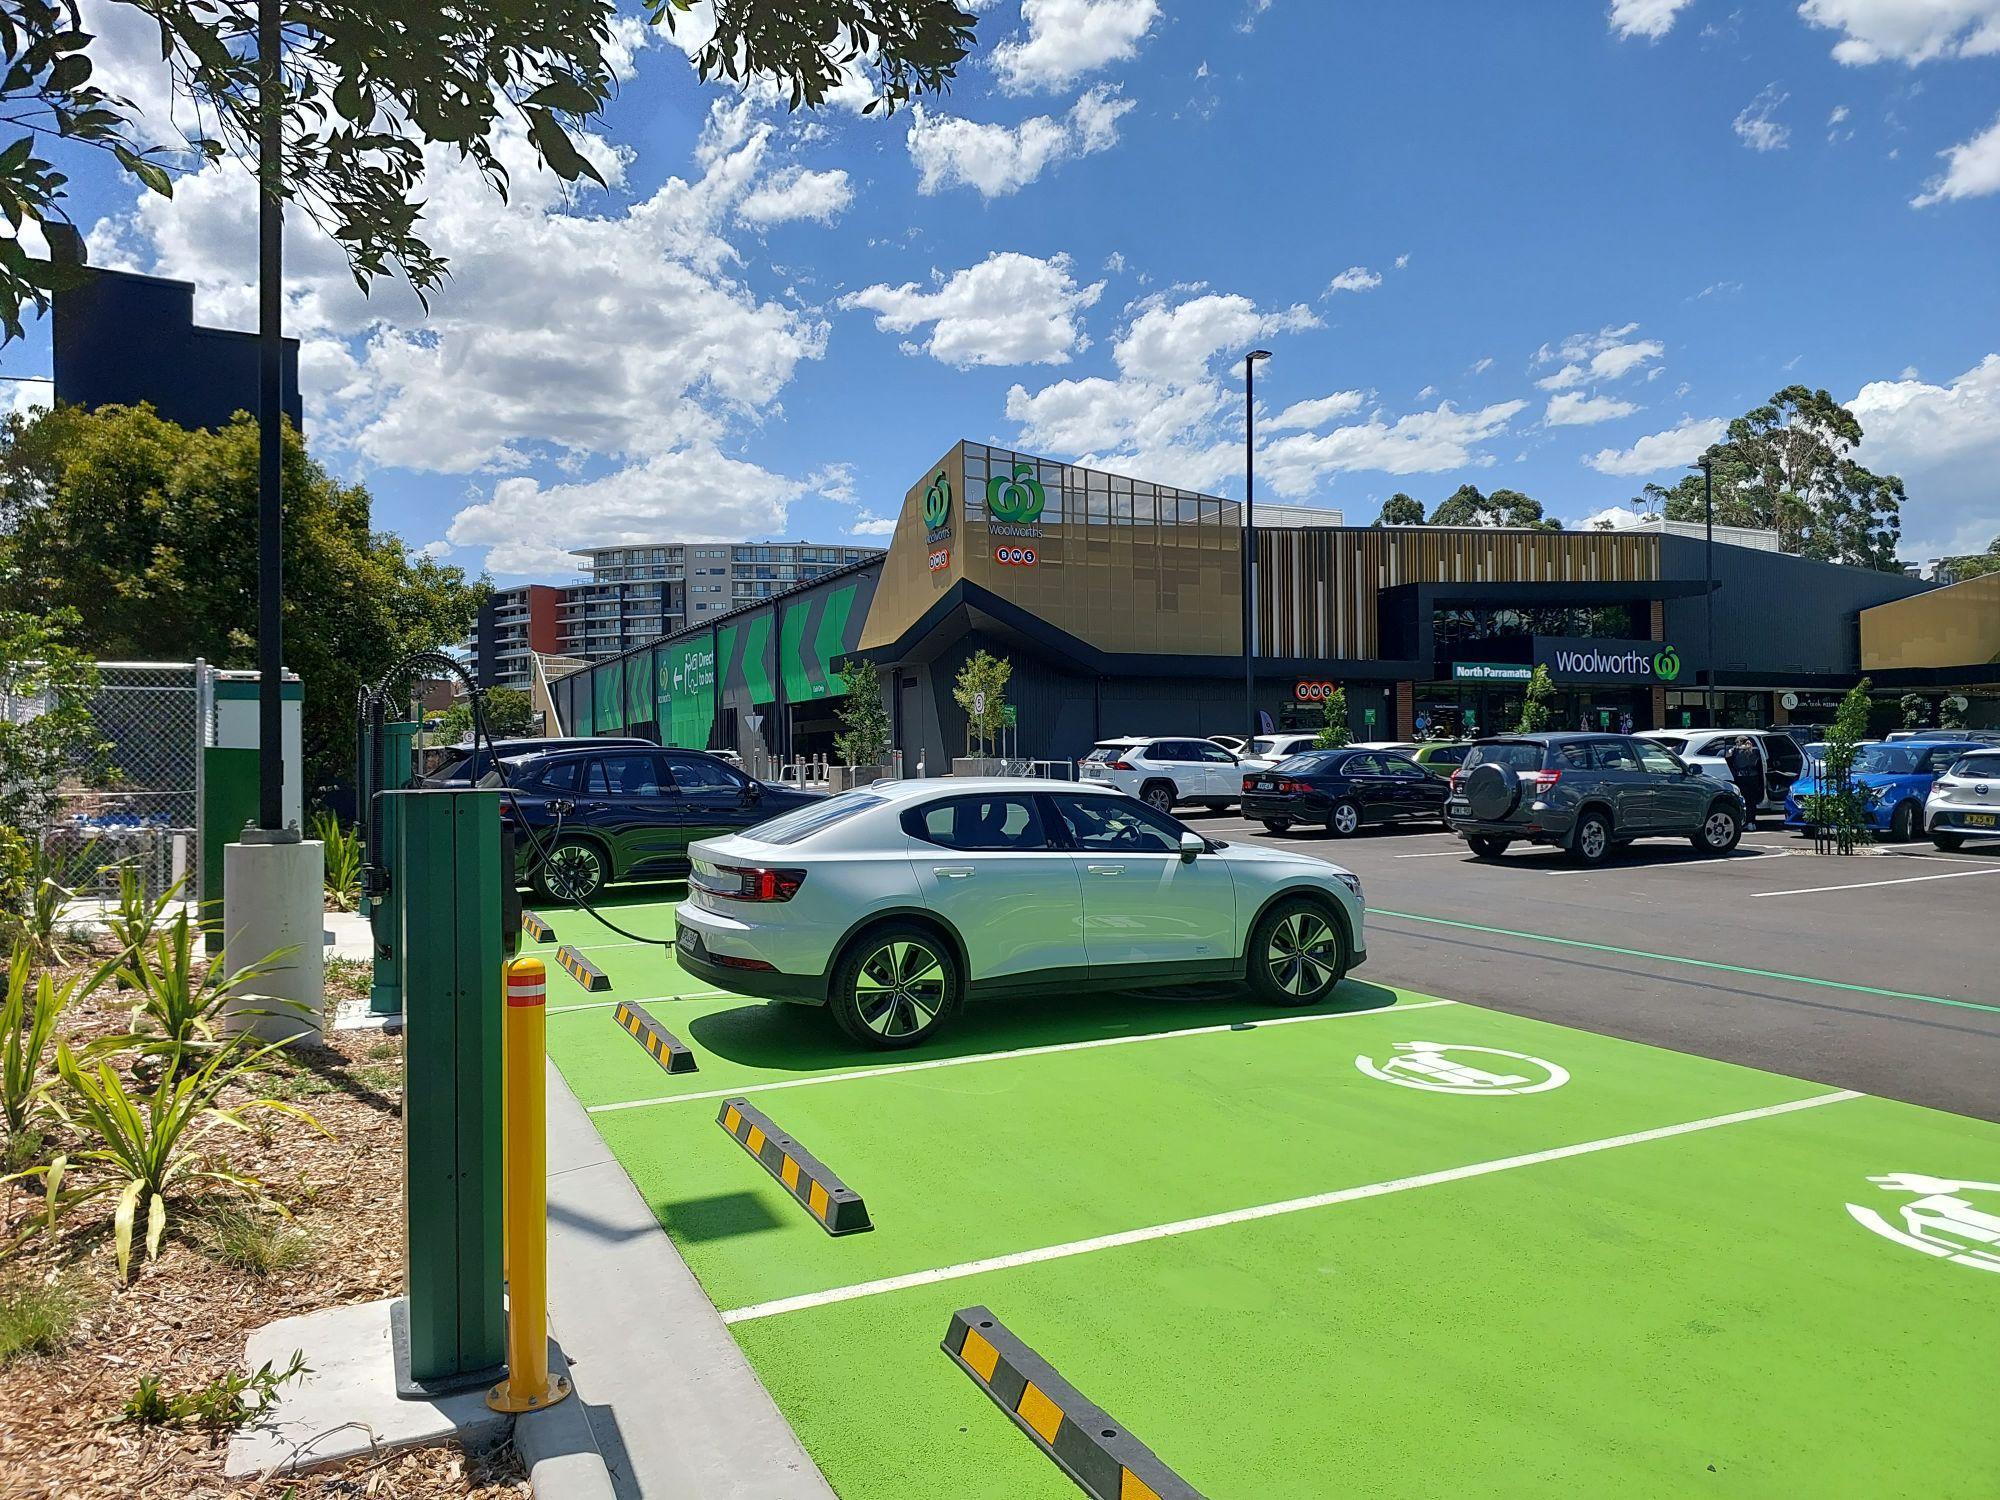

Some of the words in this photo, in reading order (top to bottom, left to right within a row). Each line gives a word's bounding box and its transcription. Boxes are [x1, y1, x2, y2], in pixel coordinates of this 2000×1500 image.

[989, 524, 1043, 538] Woolworths
[1556, 648, 1651, 675] Woolworths
[1456, 666, 1483, 678] North
[1484, 667, 1532, 679] Parramatta
